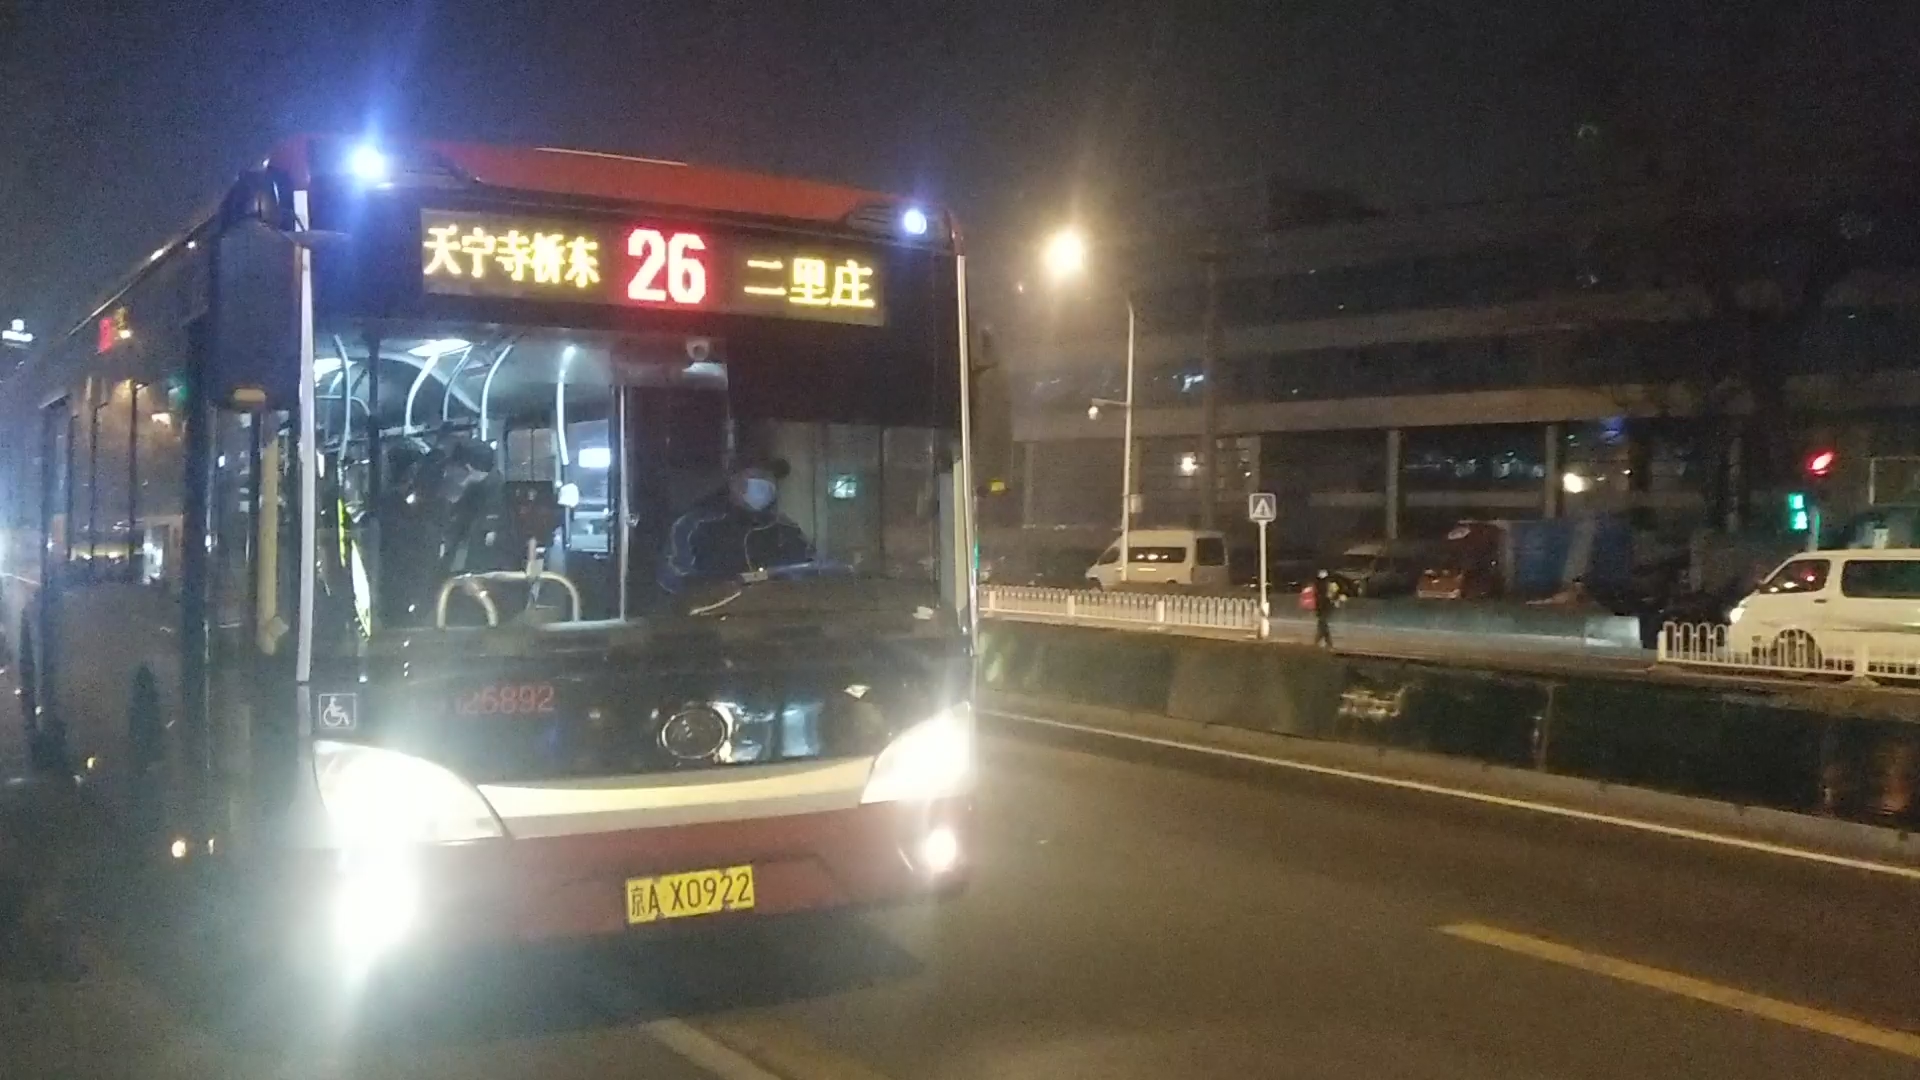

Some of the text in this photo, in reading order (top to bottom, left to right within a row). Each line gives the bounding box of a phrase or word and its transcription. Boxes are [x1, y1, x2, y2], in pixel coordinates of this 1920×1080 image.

[627, 228, 706, 304] 26
[743, 257, 876, 308] 二里庄
[630, 872, 751, 917] 京A X0922
